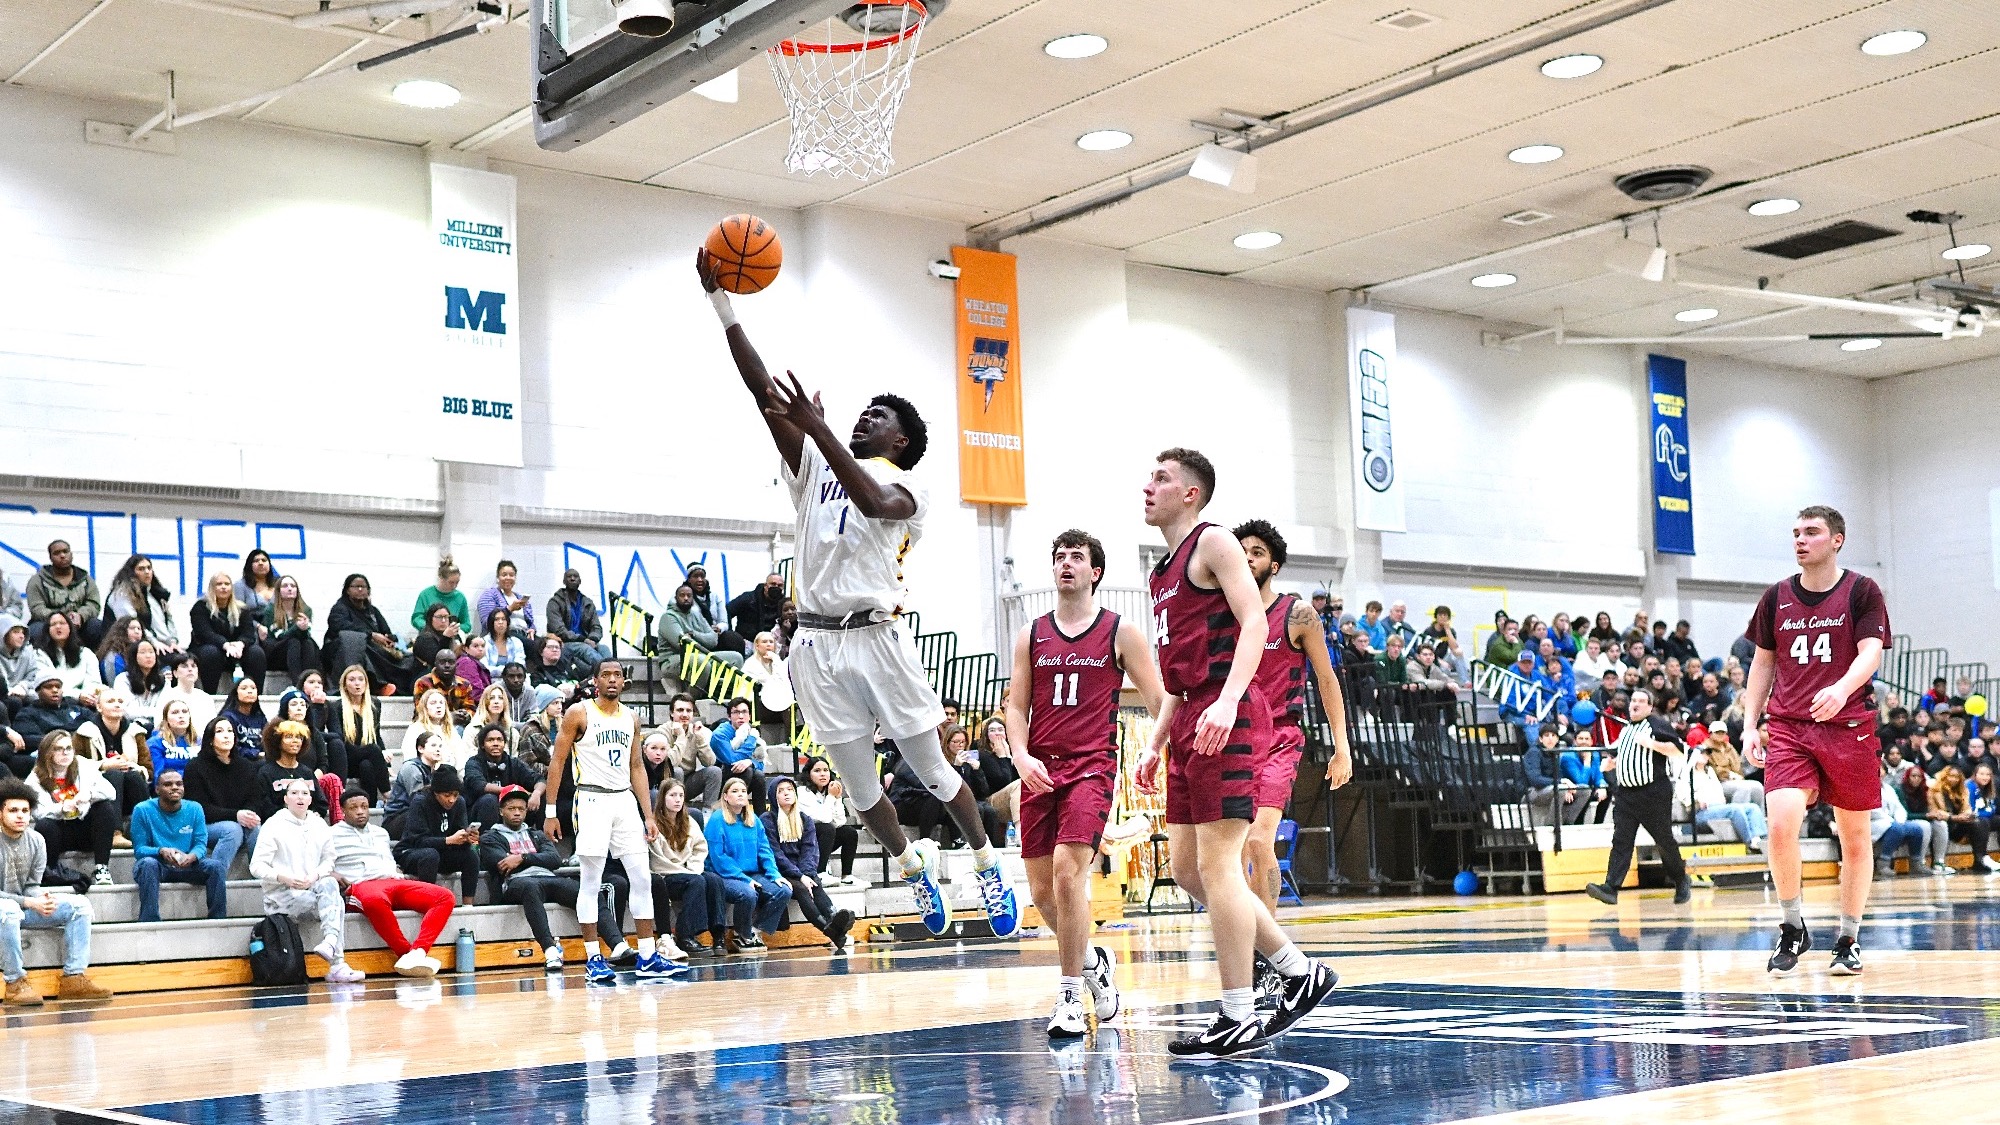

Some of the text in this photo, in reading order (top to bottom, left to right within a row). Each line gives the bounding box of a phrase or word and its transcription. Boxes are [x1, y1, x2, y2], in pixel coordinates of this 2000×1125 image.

[447, 219, 503, 238] MILLIKIN
[439, 233, 511, 255] UNIVERSITY
[445, 285, 506, 335] M
[965, 298, 1008, 314] WHEATON
[968, 312, 1006, 328] COLLEGE
[443, 396, 513, 420] BIG BLUE
[963, 430, 1021, 450] THUNDER
[1779, 613, 1846, 631] North Central
[1790, 632, 1832, 664] 44
[1034, 652, 1109, 668] North Central
[1052, 673, 1079, 706] 11
[596, 730, 630, 749] VIKINGS
[608, 749, 621, 766] 12
